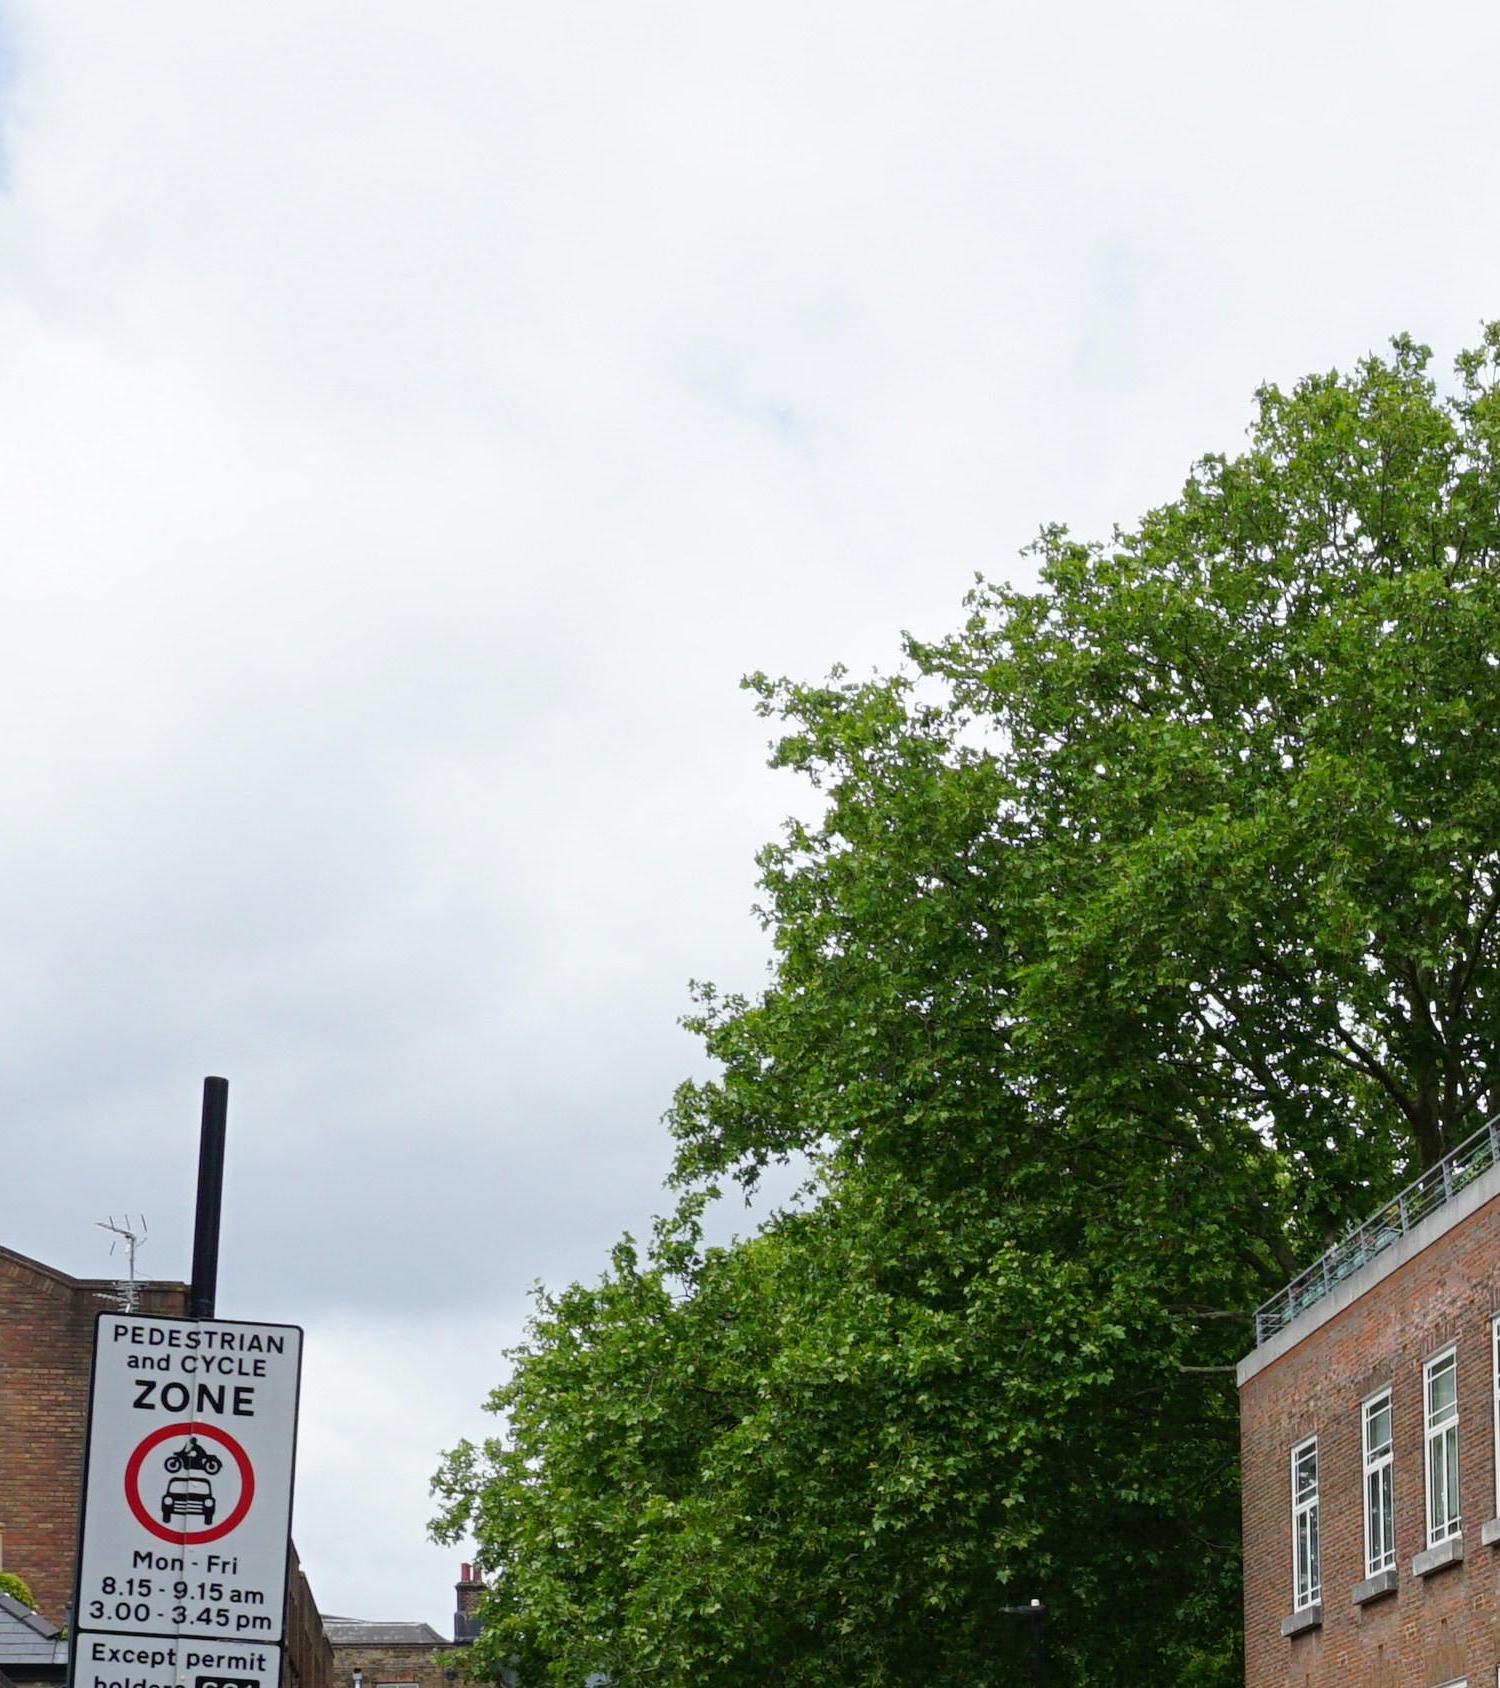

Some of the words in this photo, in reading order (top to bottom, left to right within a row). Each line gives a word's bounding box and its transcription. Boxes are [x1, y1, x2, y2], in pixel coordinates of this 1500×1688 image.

[113, 1324, 284, 1354] PEDESTRIAN
[127, 1354, 170, 1371] and
[181, 1355, 266, 1377] CYCLE
[133, 1379, 255, 1416] ZONE
[133, 1551, 184, 1572] Mon
[207, 1555, 238, 1575] Fri
[101, 1576, 152, 1597] 8.15
[173, 1581, 223, 1601] 9.15
[229, 1588, 264, 1604] am
[89, 1600, 150, 1622] 3.00
[172, 1605, 230, 1627] 3.45
[236, 1614, 272, 1631] pm
[92, 1643, 177, 1669] Except
[186, 1652, 267, 1672] permit
